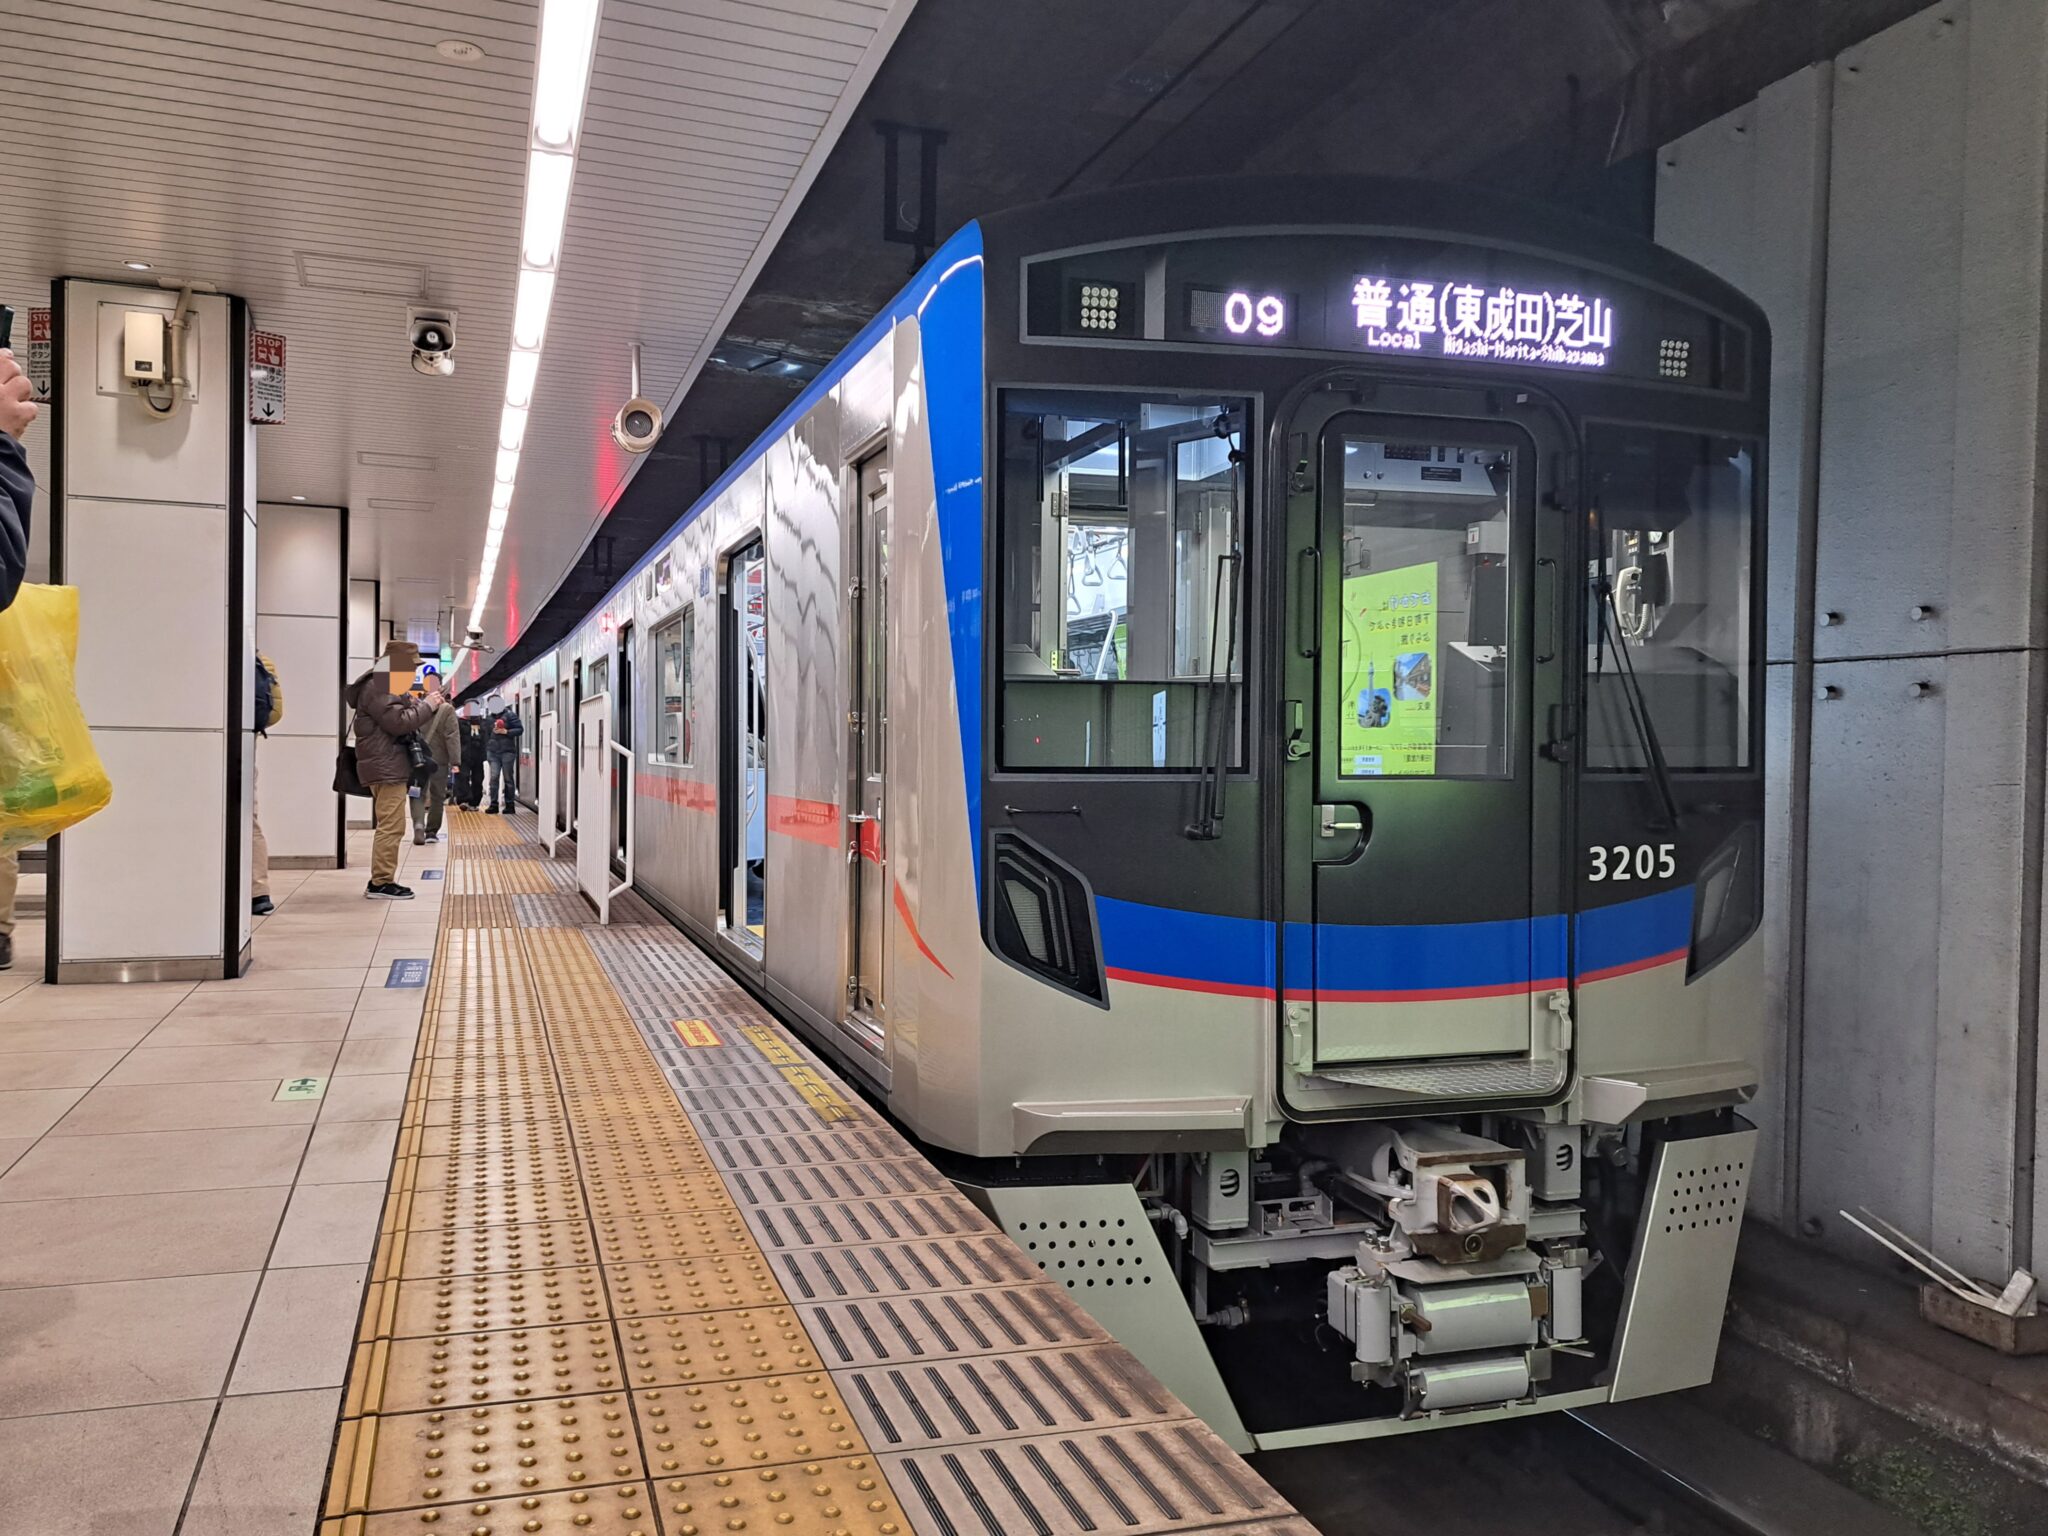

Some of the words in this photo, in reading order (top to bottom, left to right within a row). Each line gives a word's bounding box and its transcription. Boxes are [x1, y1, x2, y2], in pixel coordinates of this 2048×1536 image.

[32, 313, 50, 322] STO
[1224, 293, 1285, 336] 09
[31, 342, 50, 350] 非常停
[257, 337, 281, 347] STOP
[1367, 327, 1422, 349] Local
[1588, 843, 1676, 882] 3205
